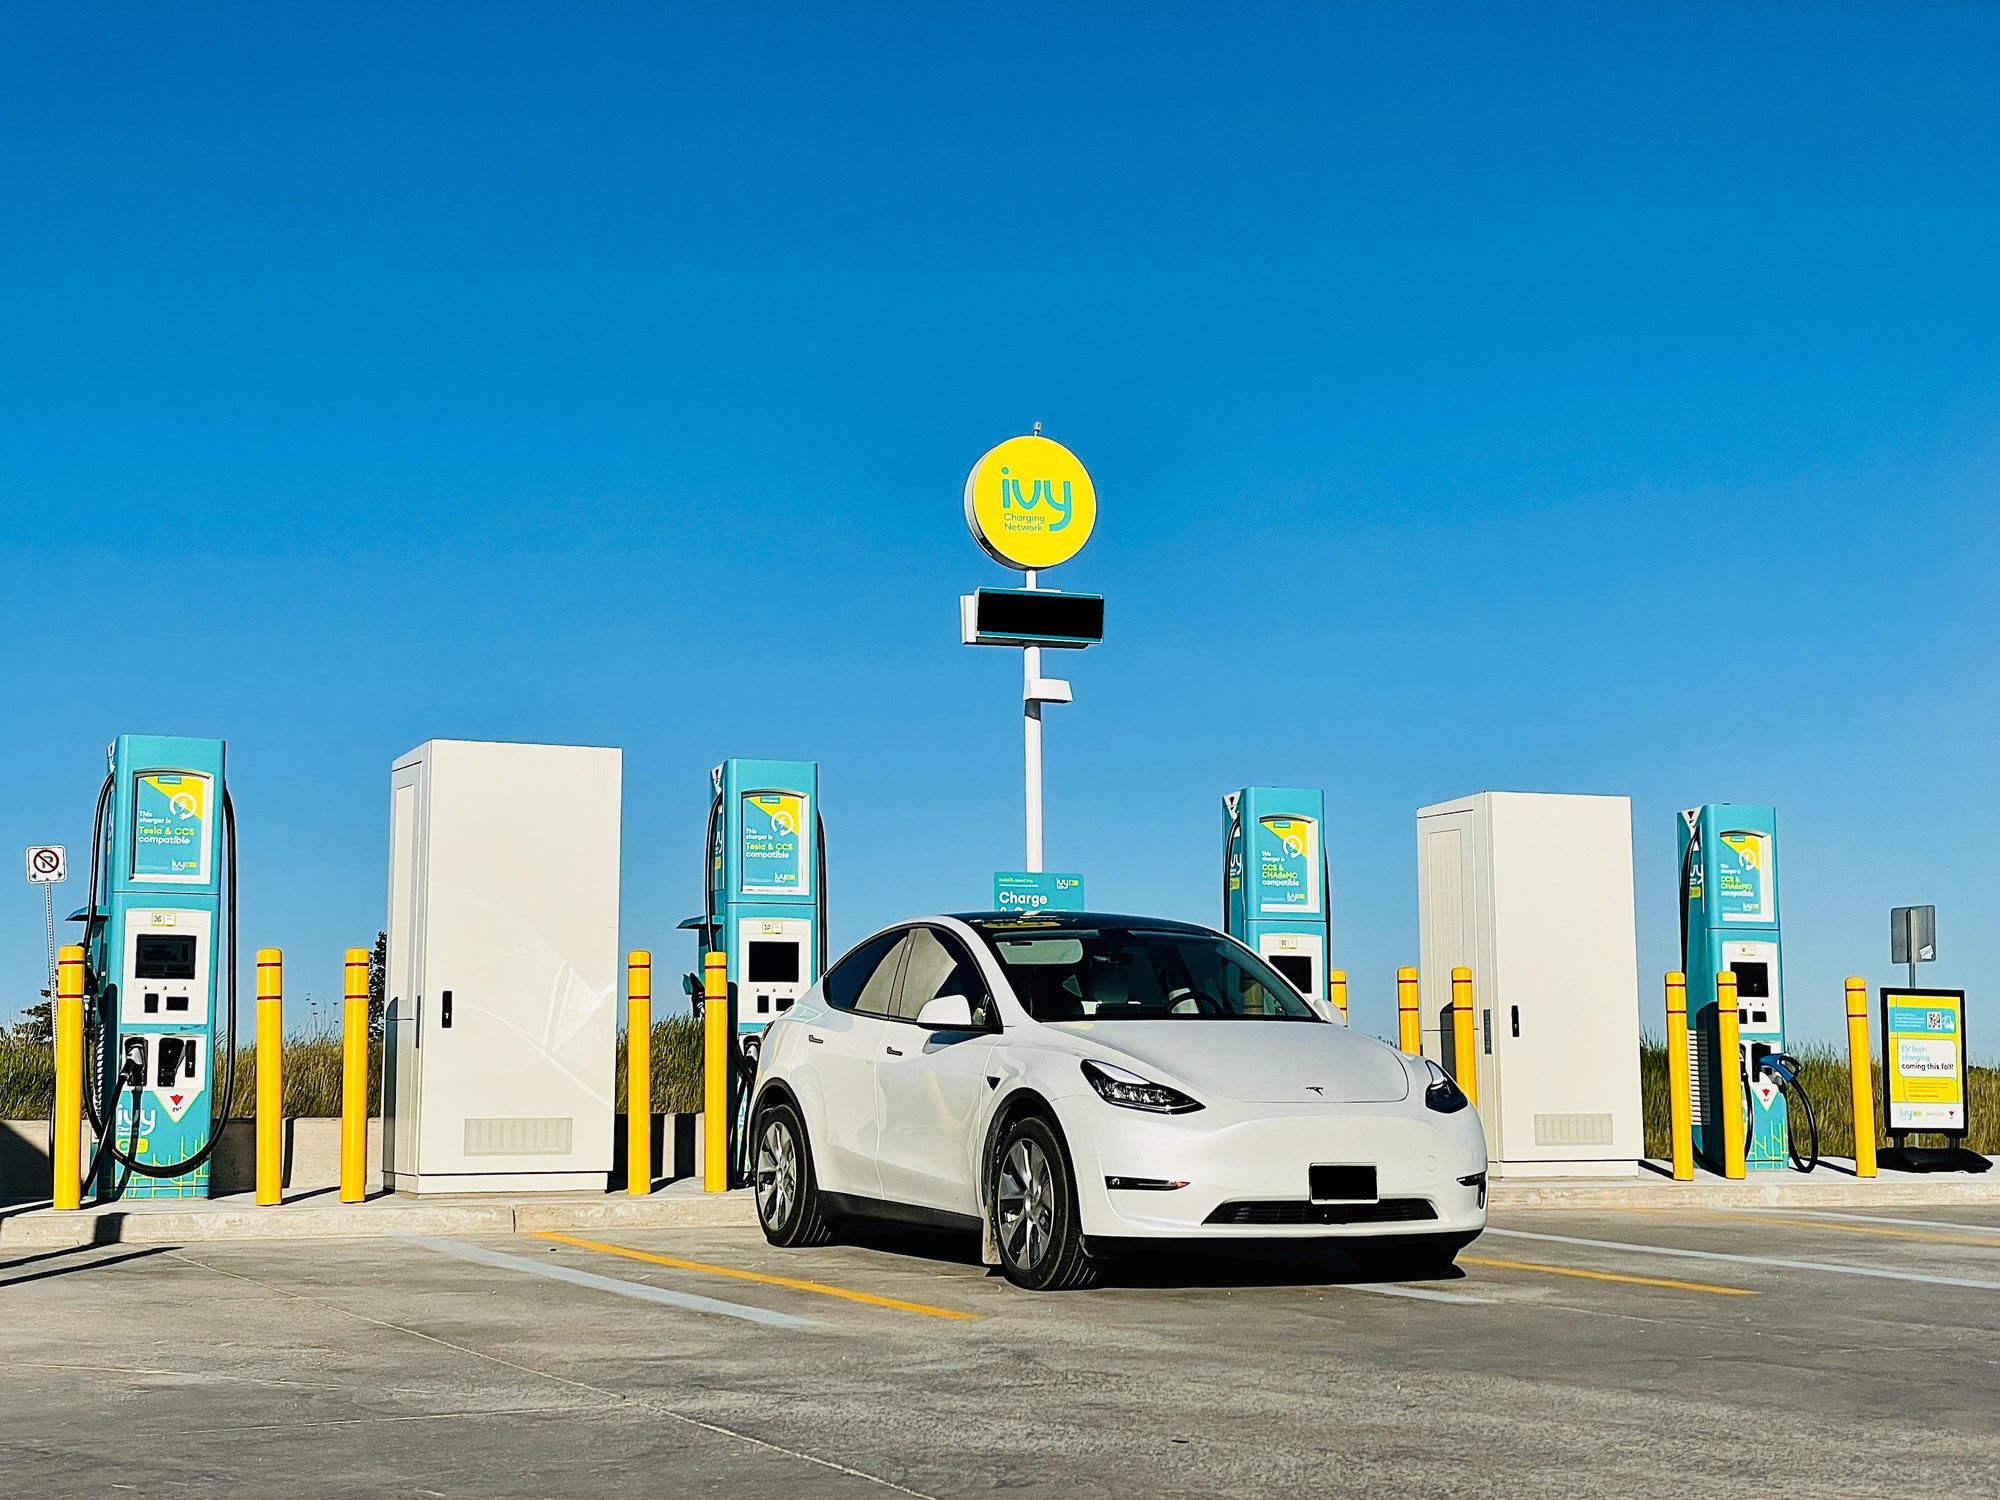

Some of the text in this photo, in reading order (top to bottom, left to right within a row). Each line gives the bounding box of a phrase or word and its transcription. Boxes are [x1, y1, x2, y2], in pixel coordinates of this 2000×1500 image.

[1002, 466, 1072, 532] ivy
[1003, 512, 1045, 524] Charging
[1004, 523, 1043, 532] Network
[139, 810, 153, 818] This
[139, 817, 165, 825] charger
[139, 826, 195, 836] Tesla & CCS
[138, 834, 191, 846] compatible
[745, 842, 793, 851] Tesla & CCS
[745, 850, 790, 860] compatible
[1262, 863, 1278, 871] CCS
[1262, 871, 1298, 879] CHAdeMO
[1262, 878, 1300, 887] compatible
[999, 890, 1048, 907] Charge
[1901, 1054, 1931, 1063] charging
[1901, 1062, 1954, 1071] coming this fall!
